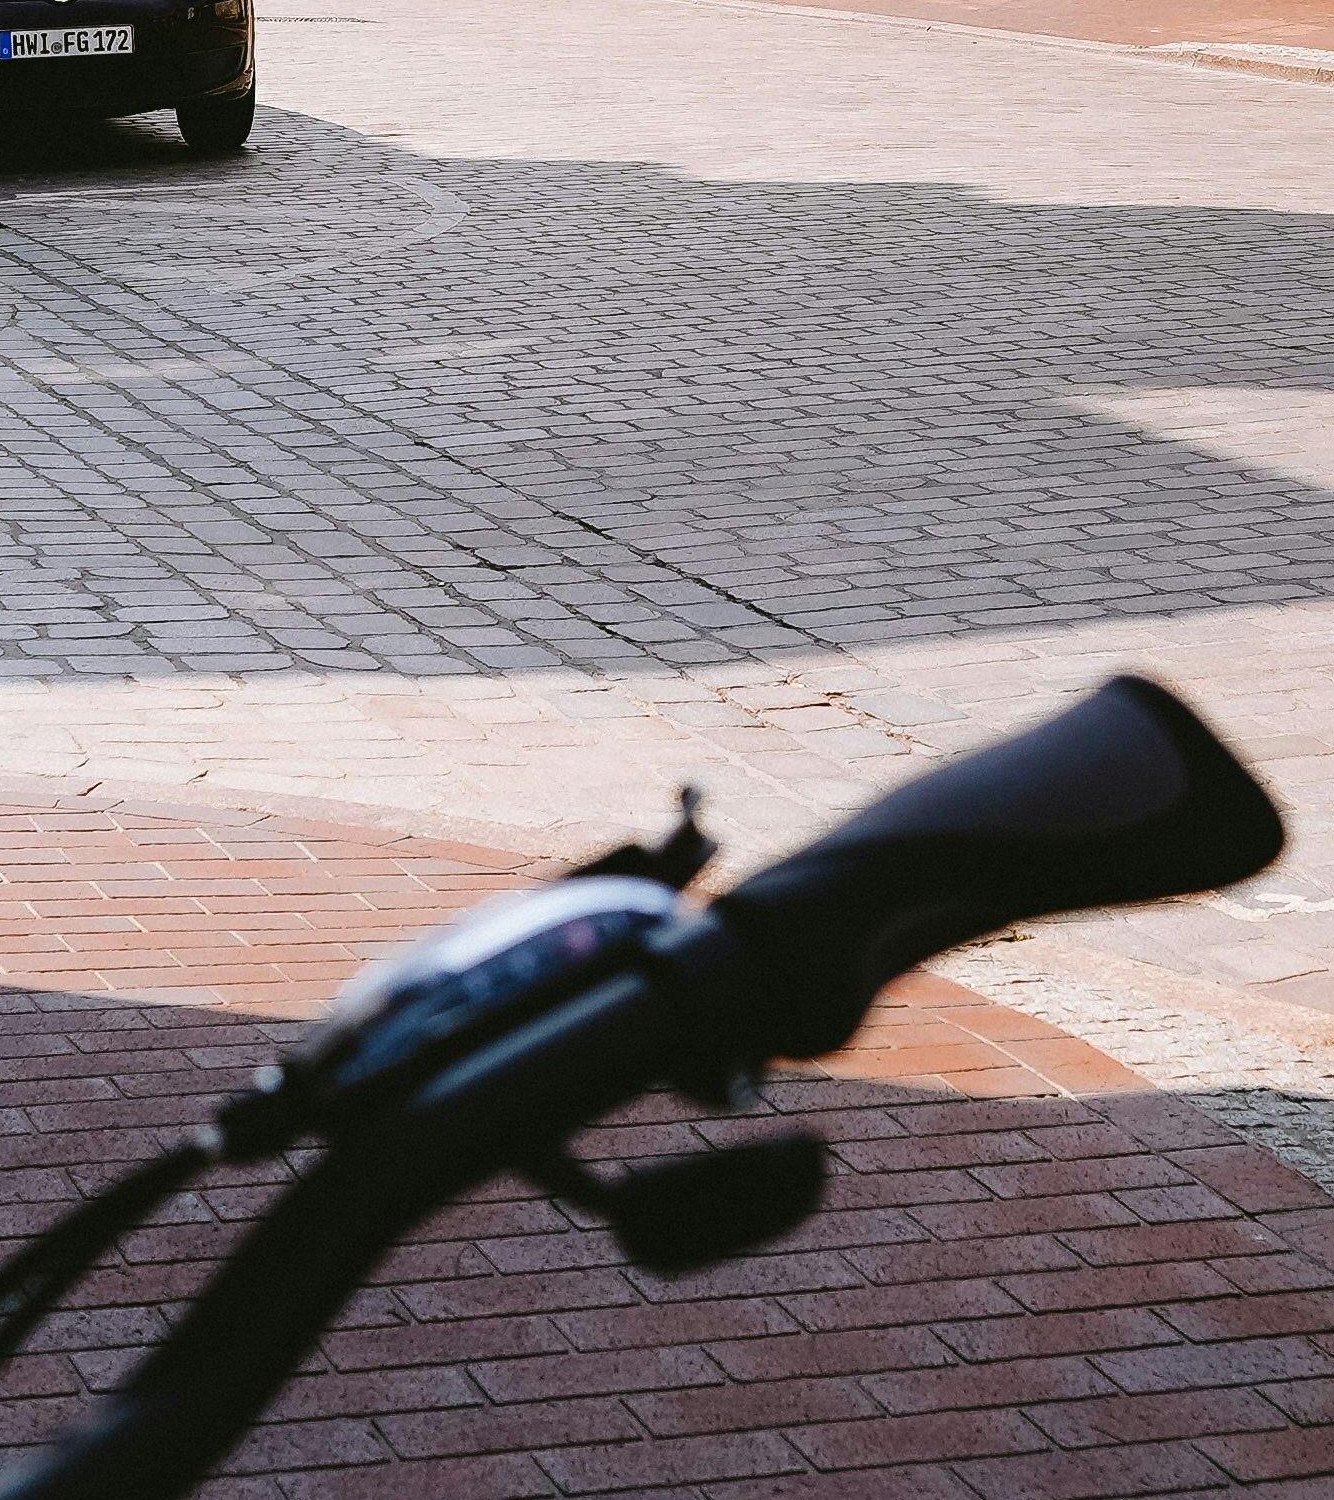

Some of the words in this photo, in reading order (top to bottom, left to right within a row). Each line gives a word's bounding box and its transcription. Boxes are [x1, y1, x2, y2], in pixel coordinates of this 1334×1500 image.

[12, 32, 50, 56] HWI
[63, 31, 90, 54] FG
[92, 29, 130, 52] 172
